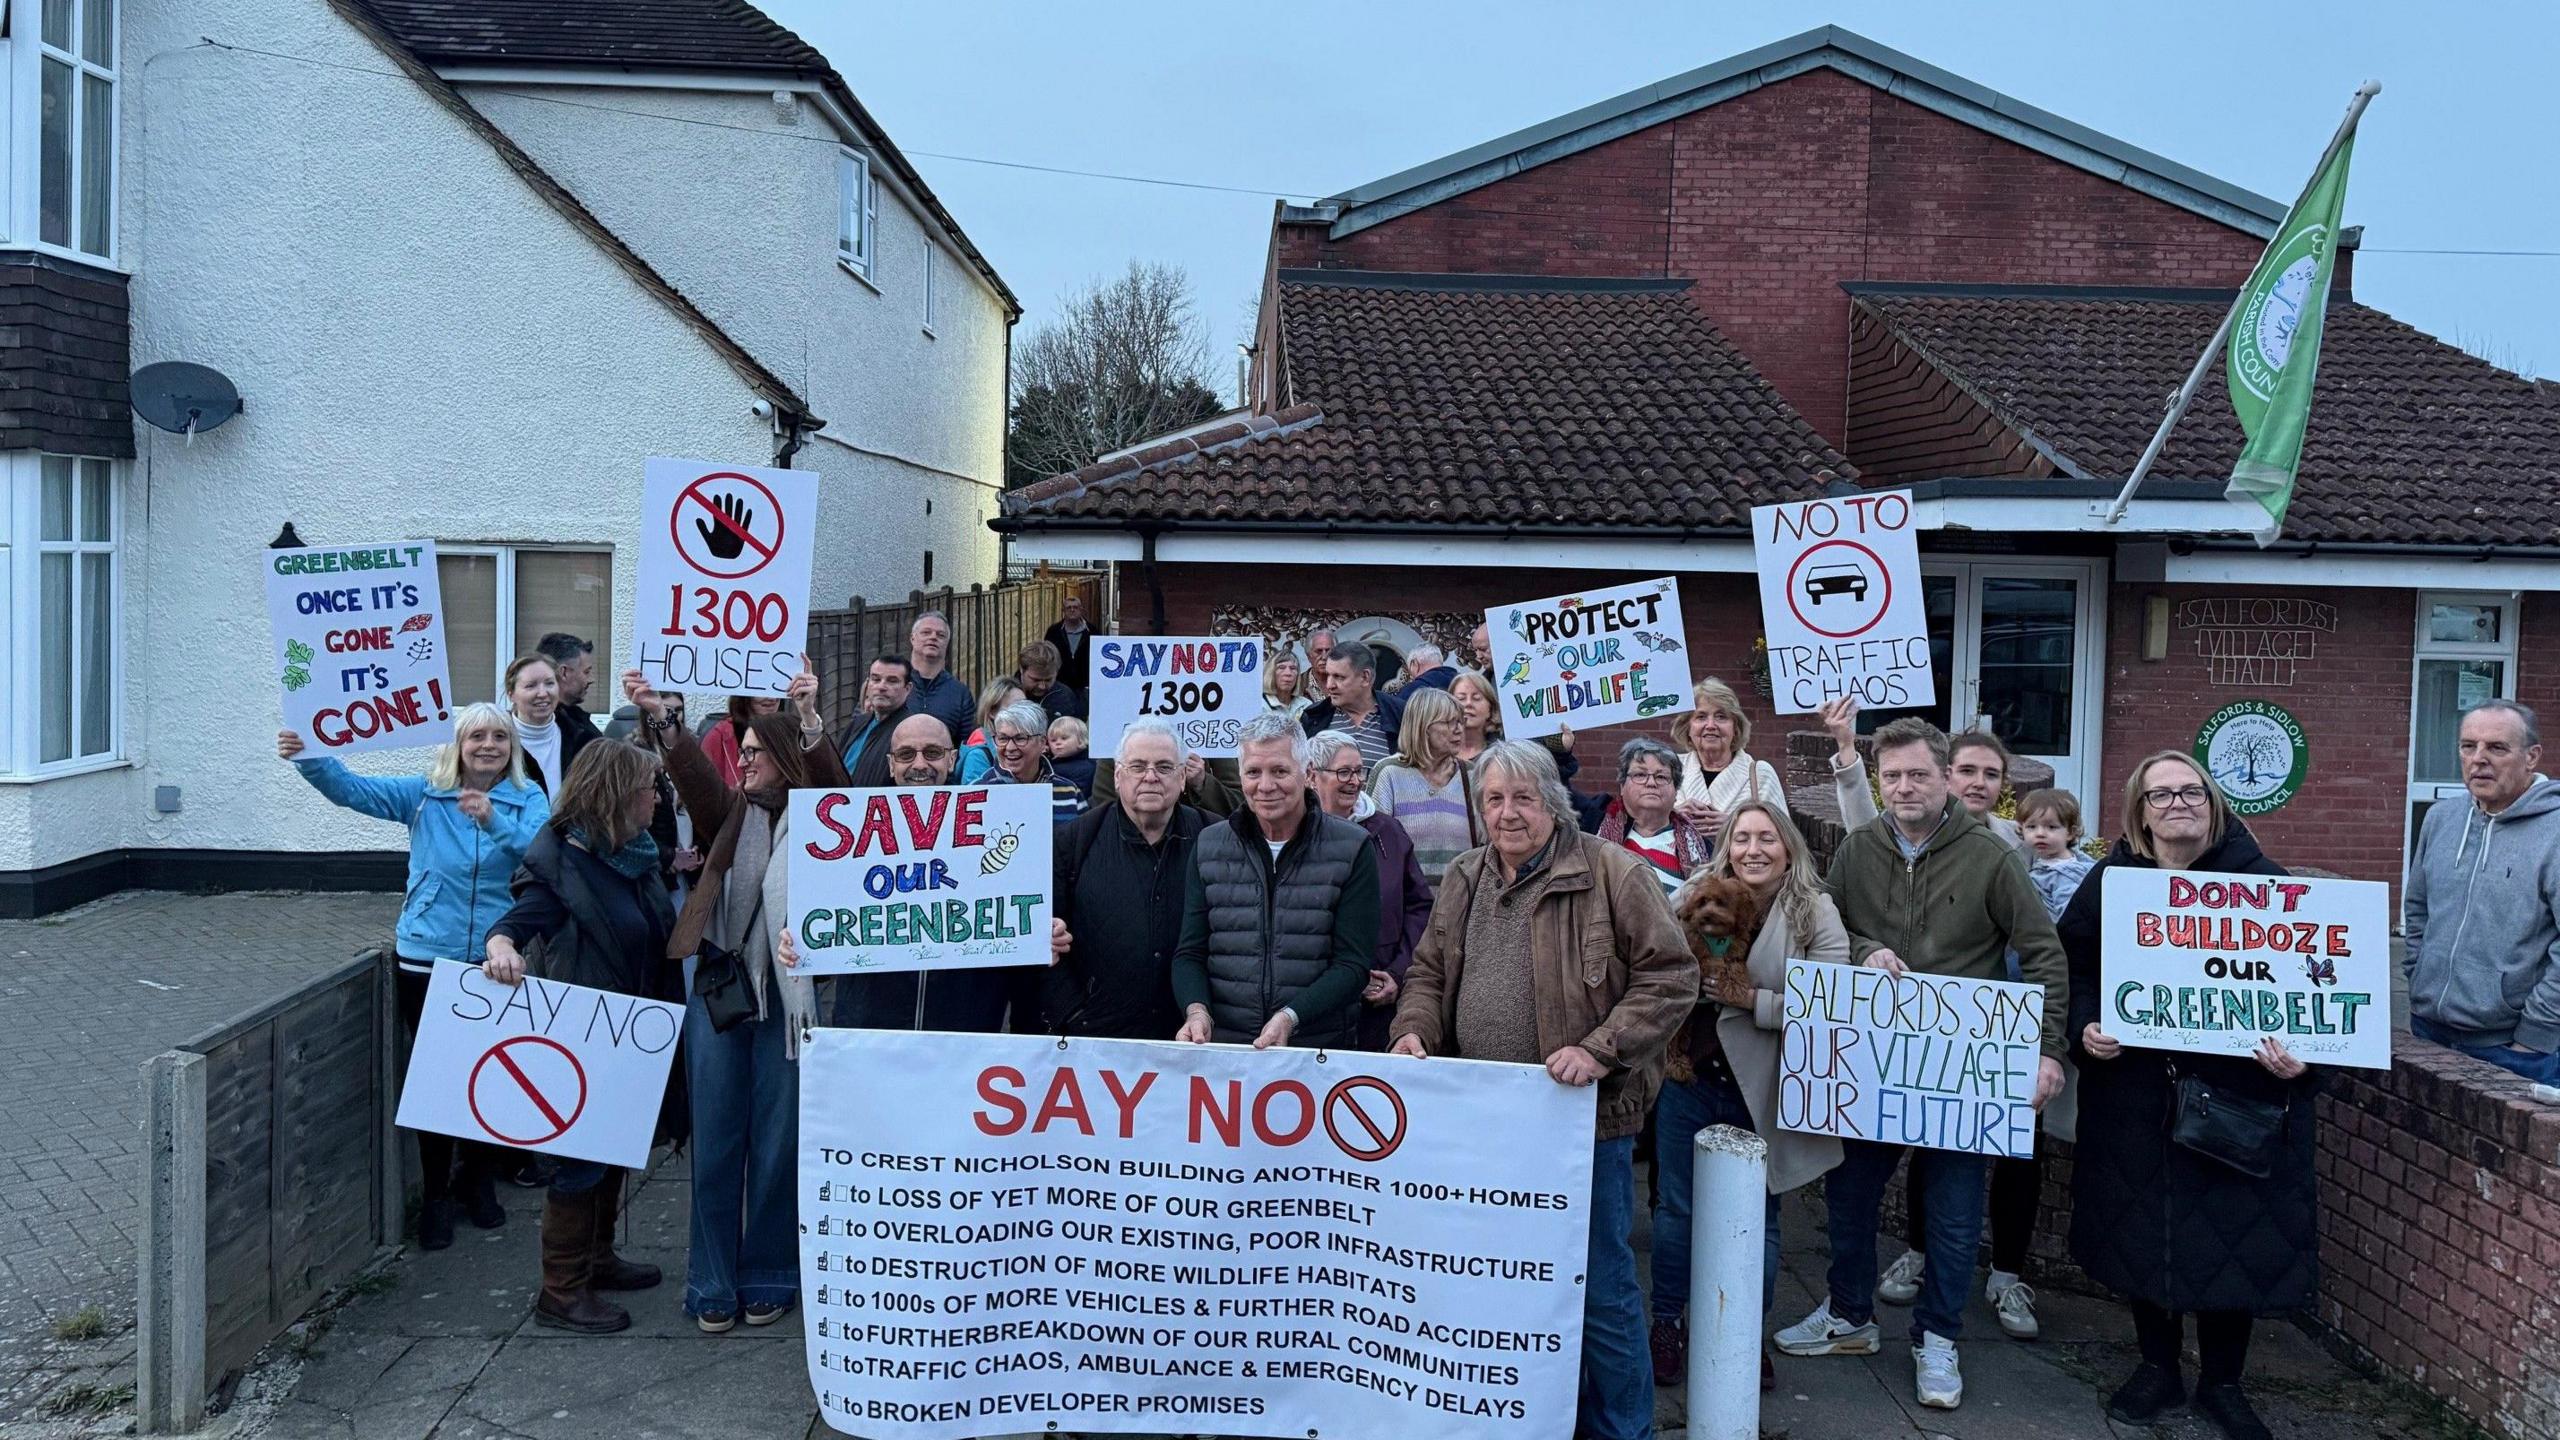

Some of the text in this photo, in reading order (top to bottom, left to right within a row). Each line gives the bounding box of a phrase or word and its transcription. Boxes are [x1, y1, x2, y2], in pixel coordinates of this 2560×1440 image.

[2241, 292, 2277, 393] PARISH COUN
[1772, 494, 1909, 544] NO TO
[273, 547, 423, 576] GREENBELT
[296, 581, 420, 615] ONCE IT'S
[661, 583, 789, 643] 1300
[1525, 593, 1663, 645] PROTECT
[2184, 598, 2330, 630] SALFORDS
[325, 626, 395, 654] GONE
[1100, 642, 1259, 679] SAY NO TO
[1557, 637, 1625, 671] OUR
[1768, 636, 1928, 678] TRAFFIC
[2203, 630, 2308, 659] VILLAGE
[341, 663, 390, 693] IT'S
[639, 641, 795, 693] HOUSES
[1793, 674, 1909, 709] CHAOS
[2221, 657, 2292, 685] HALL
[312, 678, 449, 747] GONE!
[1513, 668, 1649, 719] WILDLIFE
[2199, 702, 2305, 748] SALFORDS & SIDLOW
[2230, 718, 2275, 732] Here to Help
[805, 789, 988, 860] SAVE
[2241, 787, 2293, 814] COUNCIL
[863, 858, 958, 899] OUR
[2168, 876, 2312, 913] DON'T
[802, 894, 1043, 950] GREENBELT
[2136, 912, 2352, 957] BULLDOZE
[2204, 957, 2276, 984] OUR
[452, 967, 676, 1053] SAY NO
[1786, 966, 2043, 1043] SALFORDS SAYS
[2115, 981, 2371, 1035] GREENBELT
[1783, 1020, 2030, 1101] OUR VILLAGE
[973, 1065, 1316, 1148] SAY NO
[1780, 1074, 2034, 1158] OUR FUTURE
[820, 1148, 853, 1165] TO
[861, 1152, 946, 1172] CREST
[954, 1154, 1110, 1174] NICHOLSON
[1119, 1160, 1245, 1184] BUILDING
[1253, 1166, 1381, 1193] ANOTHER
[1469, 1187, 1568, 1211] HOMES
[851, 1186, 1376, 1227] to LOSS OF YET MORE OF OUR GREENBELT
[846, 1218, 1554, 1283] to OVERLOADING OUR EXISTING, POOR INFRASTRUCTURE
[846, 1255, 1417, 1304] to DESTRUCTION OF MORE WILDLIFE HABITATS
[844, 1288, 1562, 1353] to 1000s OF MORE VEHICLES & FURTHER ROAD ACCIDENTS
[843, 1323, 864, 1342] to
[1152, 1328, 1187, 1347] OF
[1194, 1330, 1248, 1349] OUR
[1256, 1330, 1341, 1350] RURAL
[1347, 1335, 1519, 1386] COMMUNITIES
[843, 1351, 1526, 1419] to TRAFFIC CHAOS, AMBULANCE & EMERGENCY DELAYS
[843, 1392, 1265, 1423] to BROKEN DEVELOPER PROMISES
